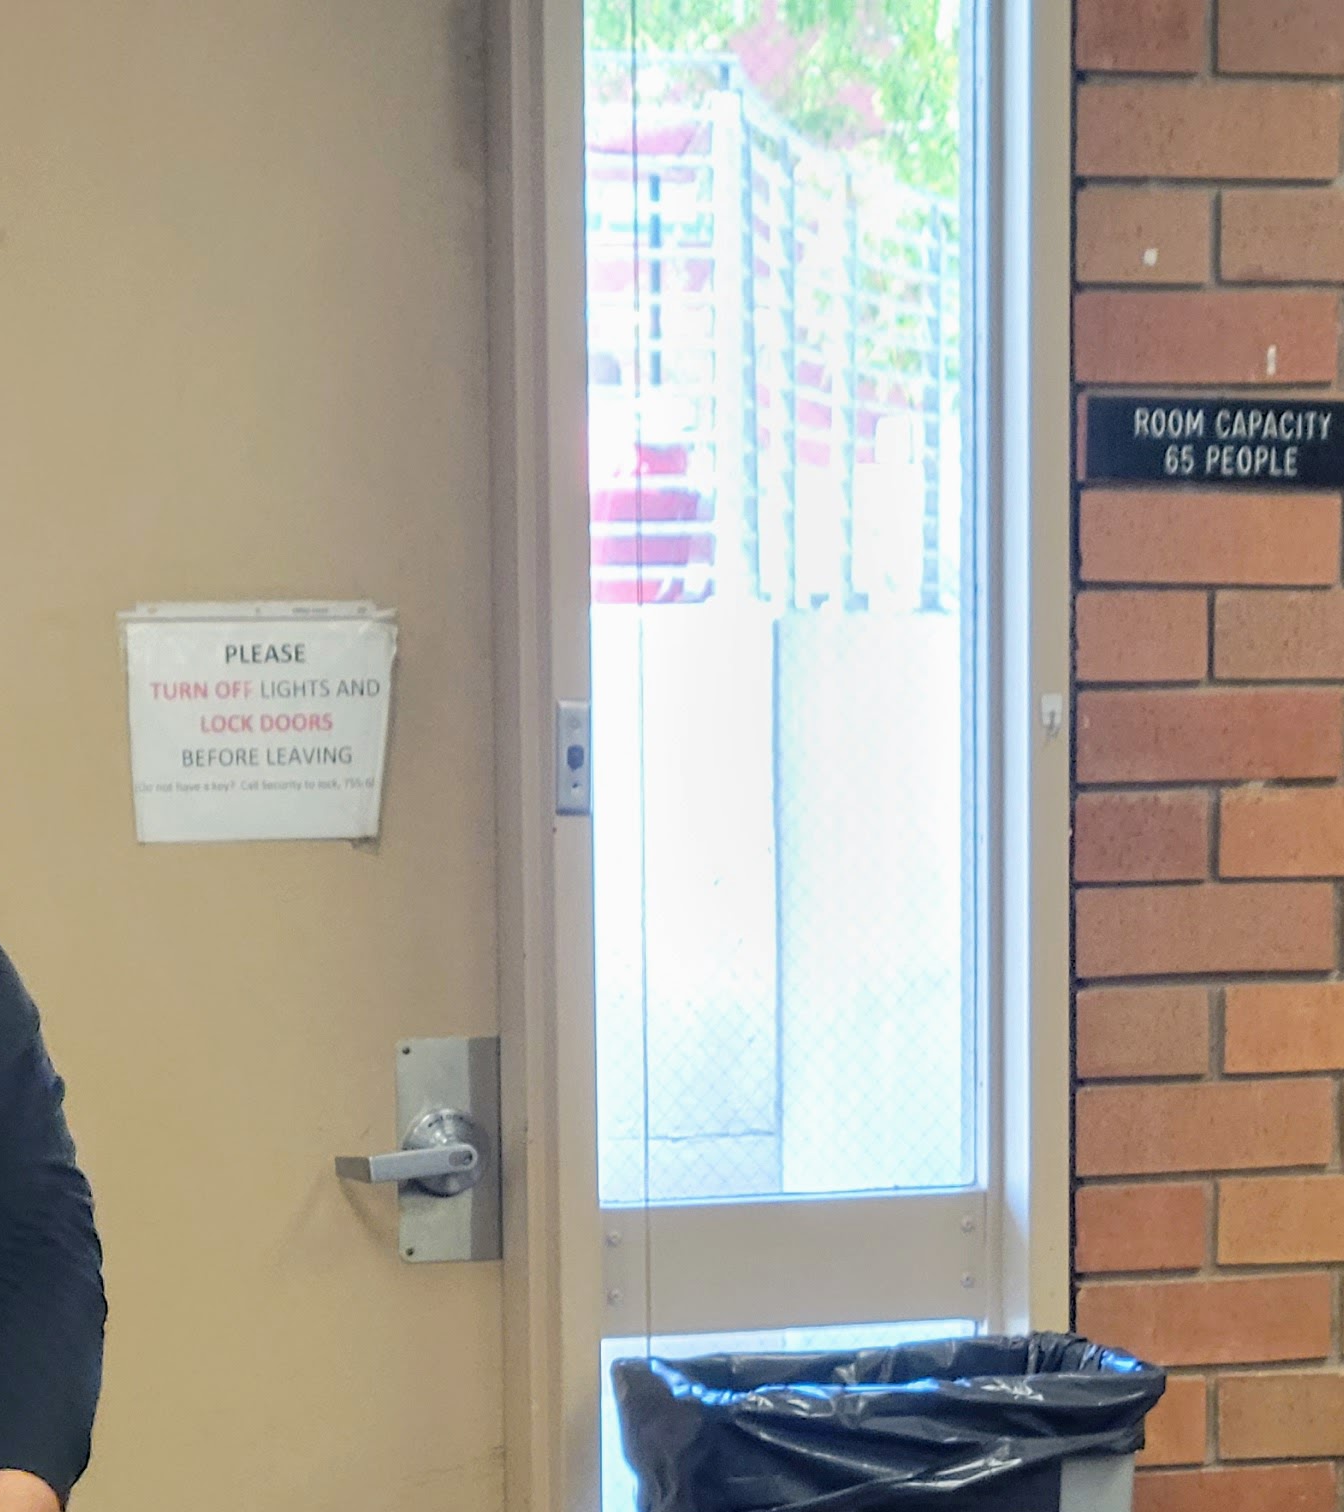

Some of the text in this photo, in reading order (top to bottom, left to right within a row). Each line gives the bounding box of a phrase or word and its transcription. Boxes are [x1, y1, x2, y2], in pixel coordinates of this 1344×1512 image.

[1133, 407, 1332, 440] ROOM CAPACITY
[1165, 444, 1298, 477] 65 PEOPLE
[225, 643, 306, 665] PLEASE
[150, 678, 381, 700] TURN OFF LIGHTS AND
[200, 712, 333, 734] LOCK DOORS
[182, 745, 353, 768] BEFORE LEAVING
